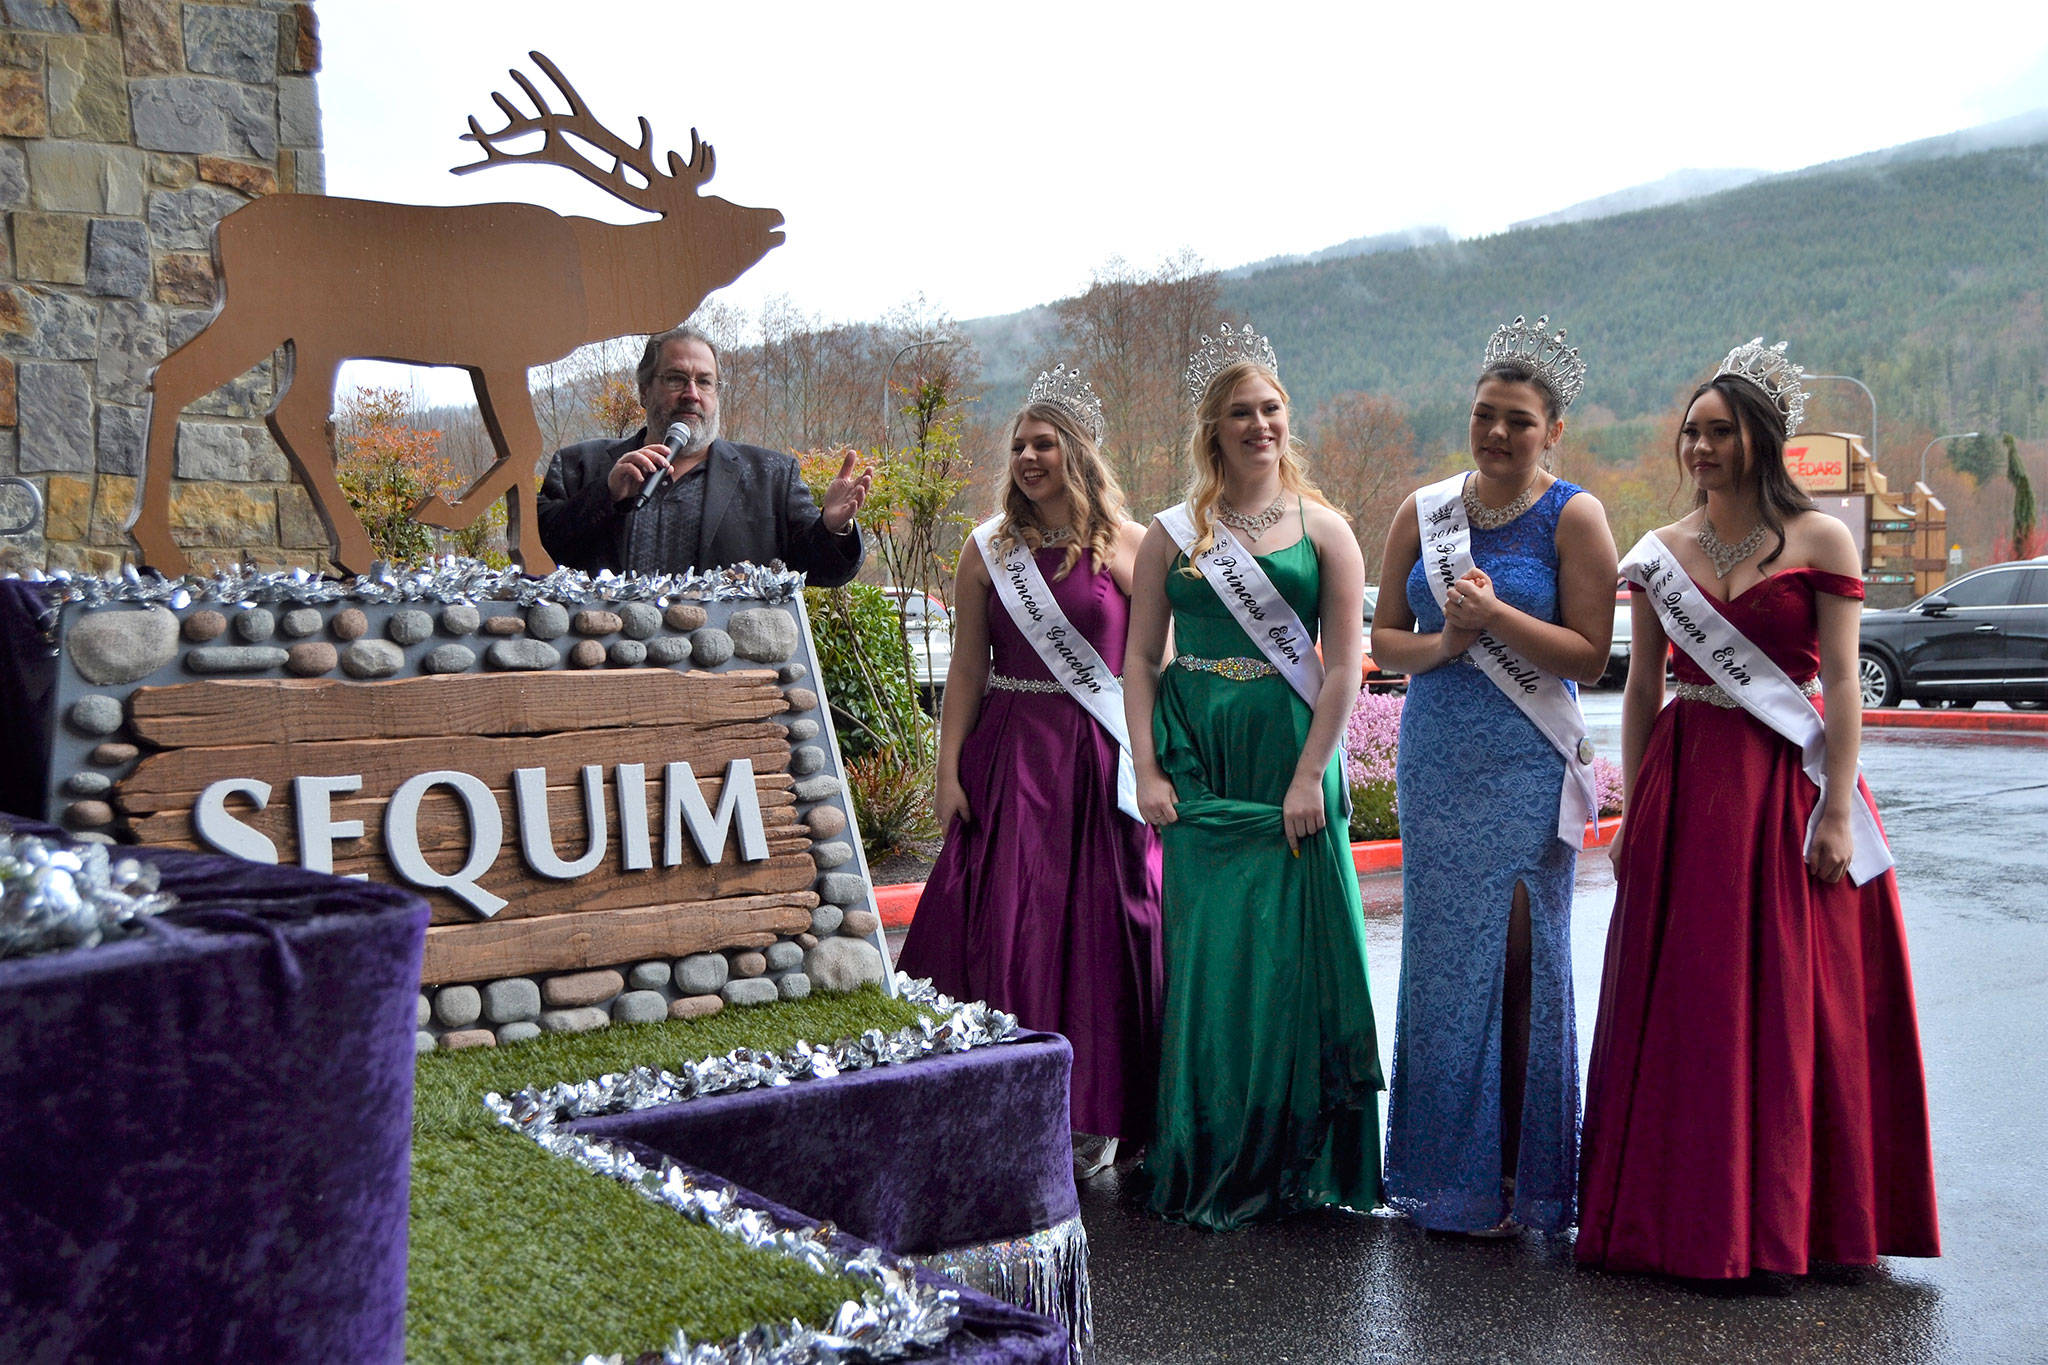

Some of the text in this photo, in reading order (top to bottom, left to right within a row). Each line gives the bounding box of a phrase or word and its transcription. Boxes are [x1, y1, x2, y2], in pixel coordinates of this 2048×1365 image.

[1201, 539, 1228, 559] 2018
[1430, 524, 1460, 541] 2018
[1006, 561, 1103, 695] Princess Gracelyn
[1213, 555, 1301, 666] Princess Eden
[1436, 543, 1541, 694] Prin abrielle
[1662, 591, 1751, 687] Queen Erin
[194, 757, 771, 918] SEQUIM
